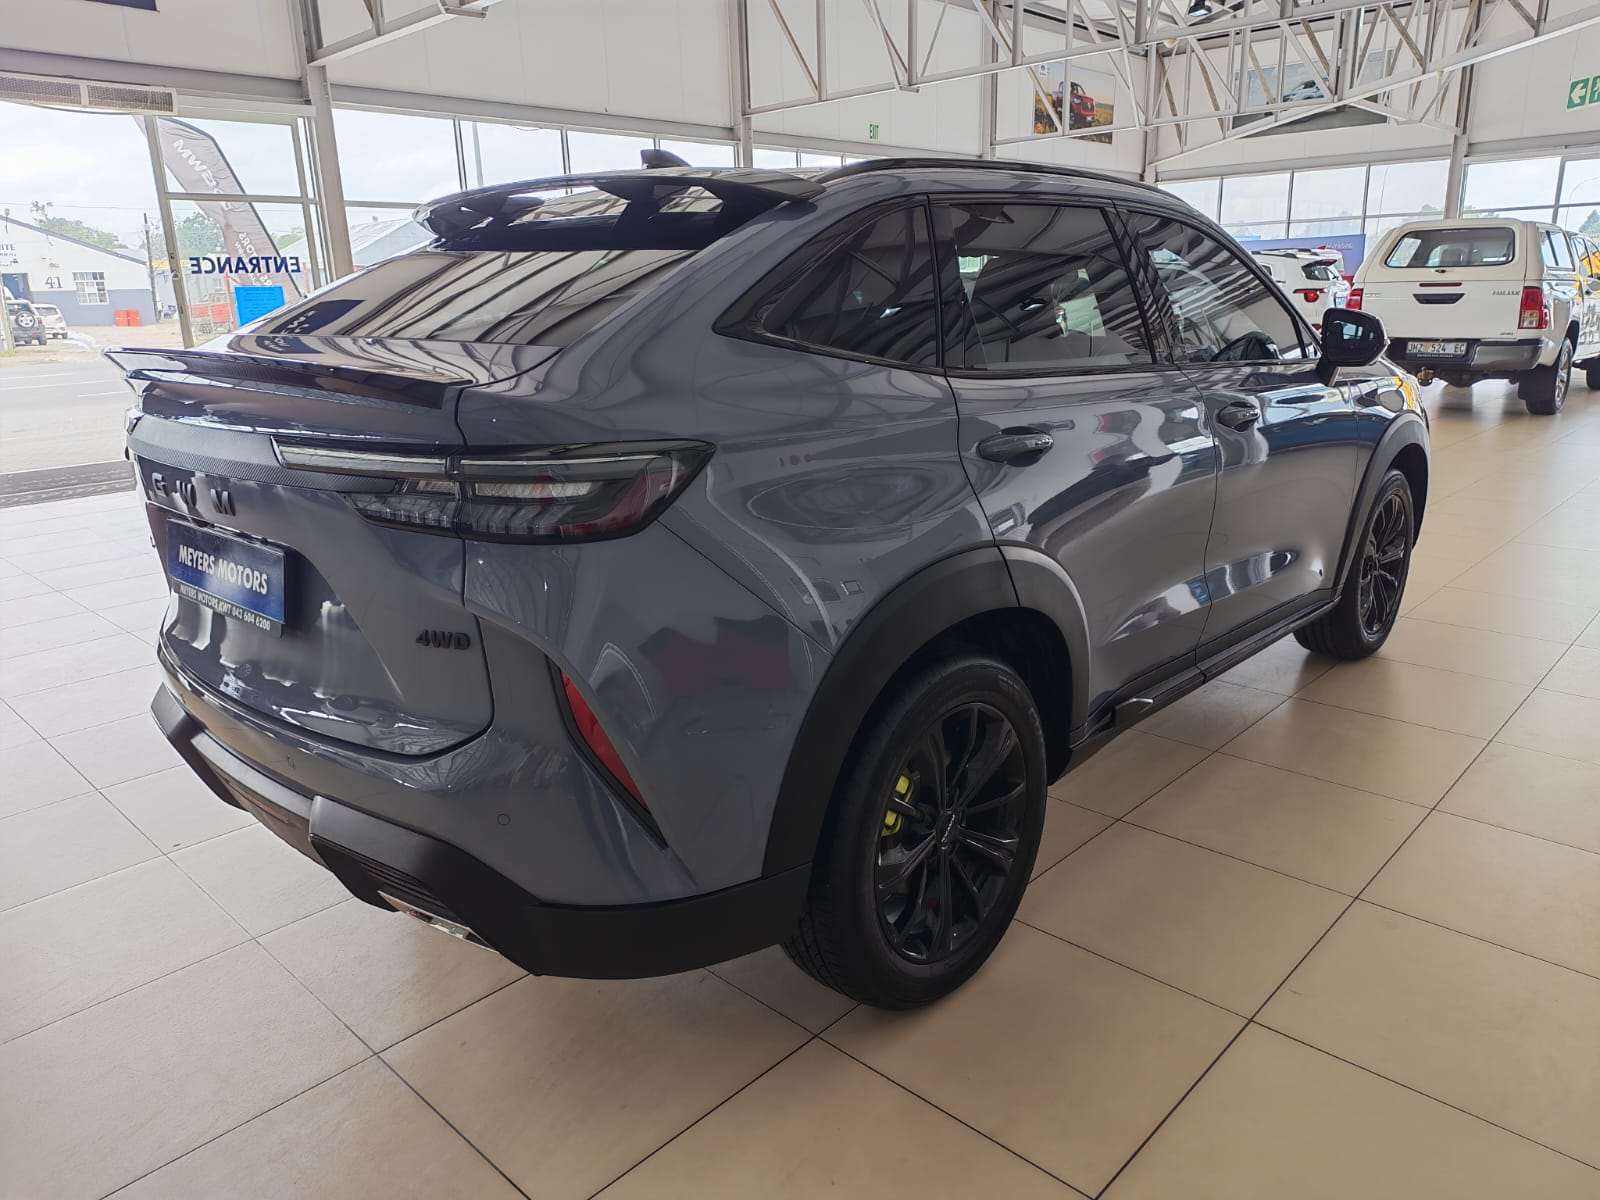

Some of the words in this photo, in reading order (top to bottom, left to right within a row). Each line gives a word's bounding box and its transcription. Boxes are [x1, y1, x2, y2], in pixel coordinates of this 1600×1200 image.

[869, 124, 879, 139] EXIT
[1431, 343, 1446, 353] 524
[1454, 343, 1465, 353] EC
[178, 544, 215, 575] MEYERS
[217, 558, 268, 596] MOTORS
[416, 629, 472, 651] 4WD
